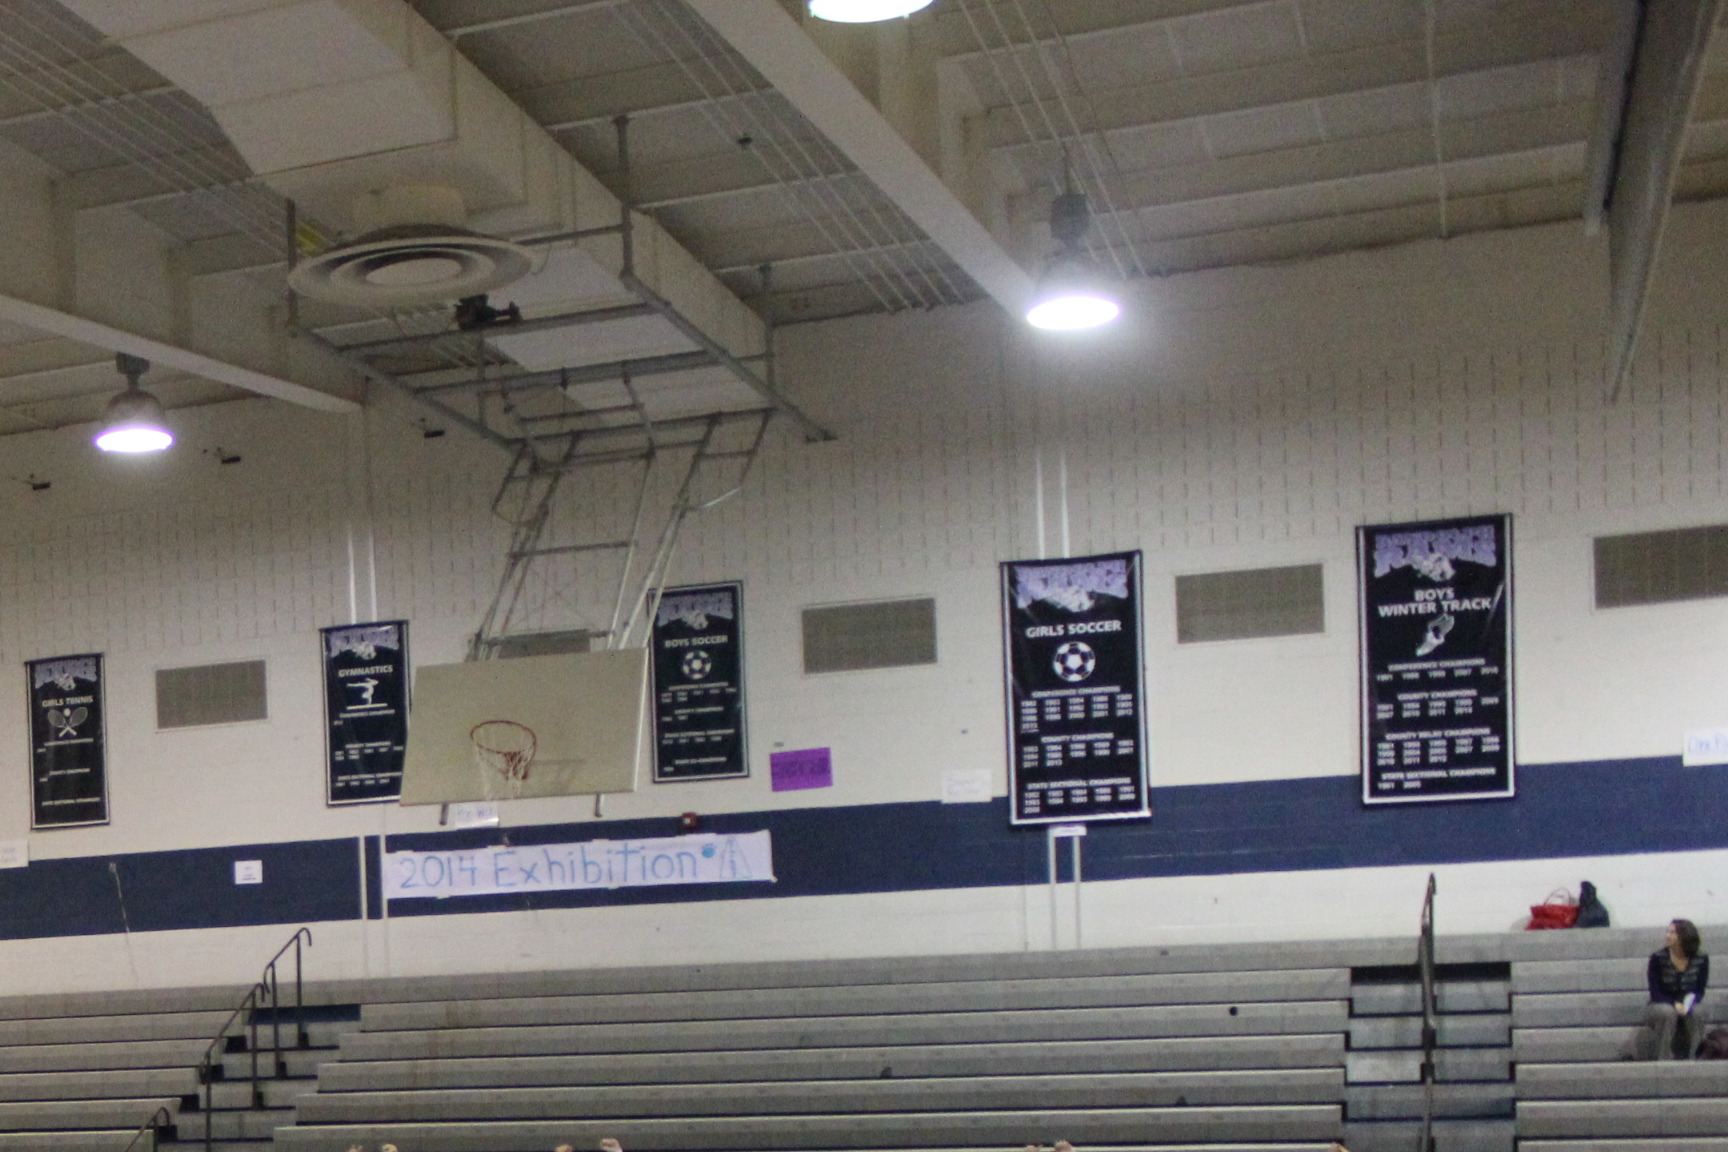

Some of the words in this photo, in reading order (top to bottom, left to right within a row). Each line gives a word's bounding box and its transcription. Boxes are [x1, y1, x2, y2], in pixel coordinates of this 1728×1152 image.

[1414, 587, 1455, 601] BOYS
[1377, 602, 1437, 617] WINTER
[1440, 598, 1492, 611] TRACK
[1025, 624, 1065, 638] GIRLS
[1068, 620, 1122, 635] SOCCER
[665, 638, 689, 648] BOYS
[691, 634, 728, 646] SOCCER
[338, 664, 393, 678] GYMNASTICS
[41, 699, 64, 708] GIRLS
[65, 695, 94, 705] TENNIS
[399, 855, 478, 889] 2014
[492, 842, 699, 888] Exhibition
